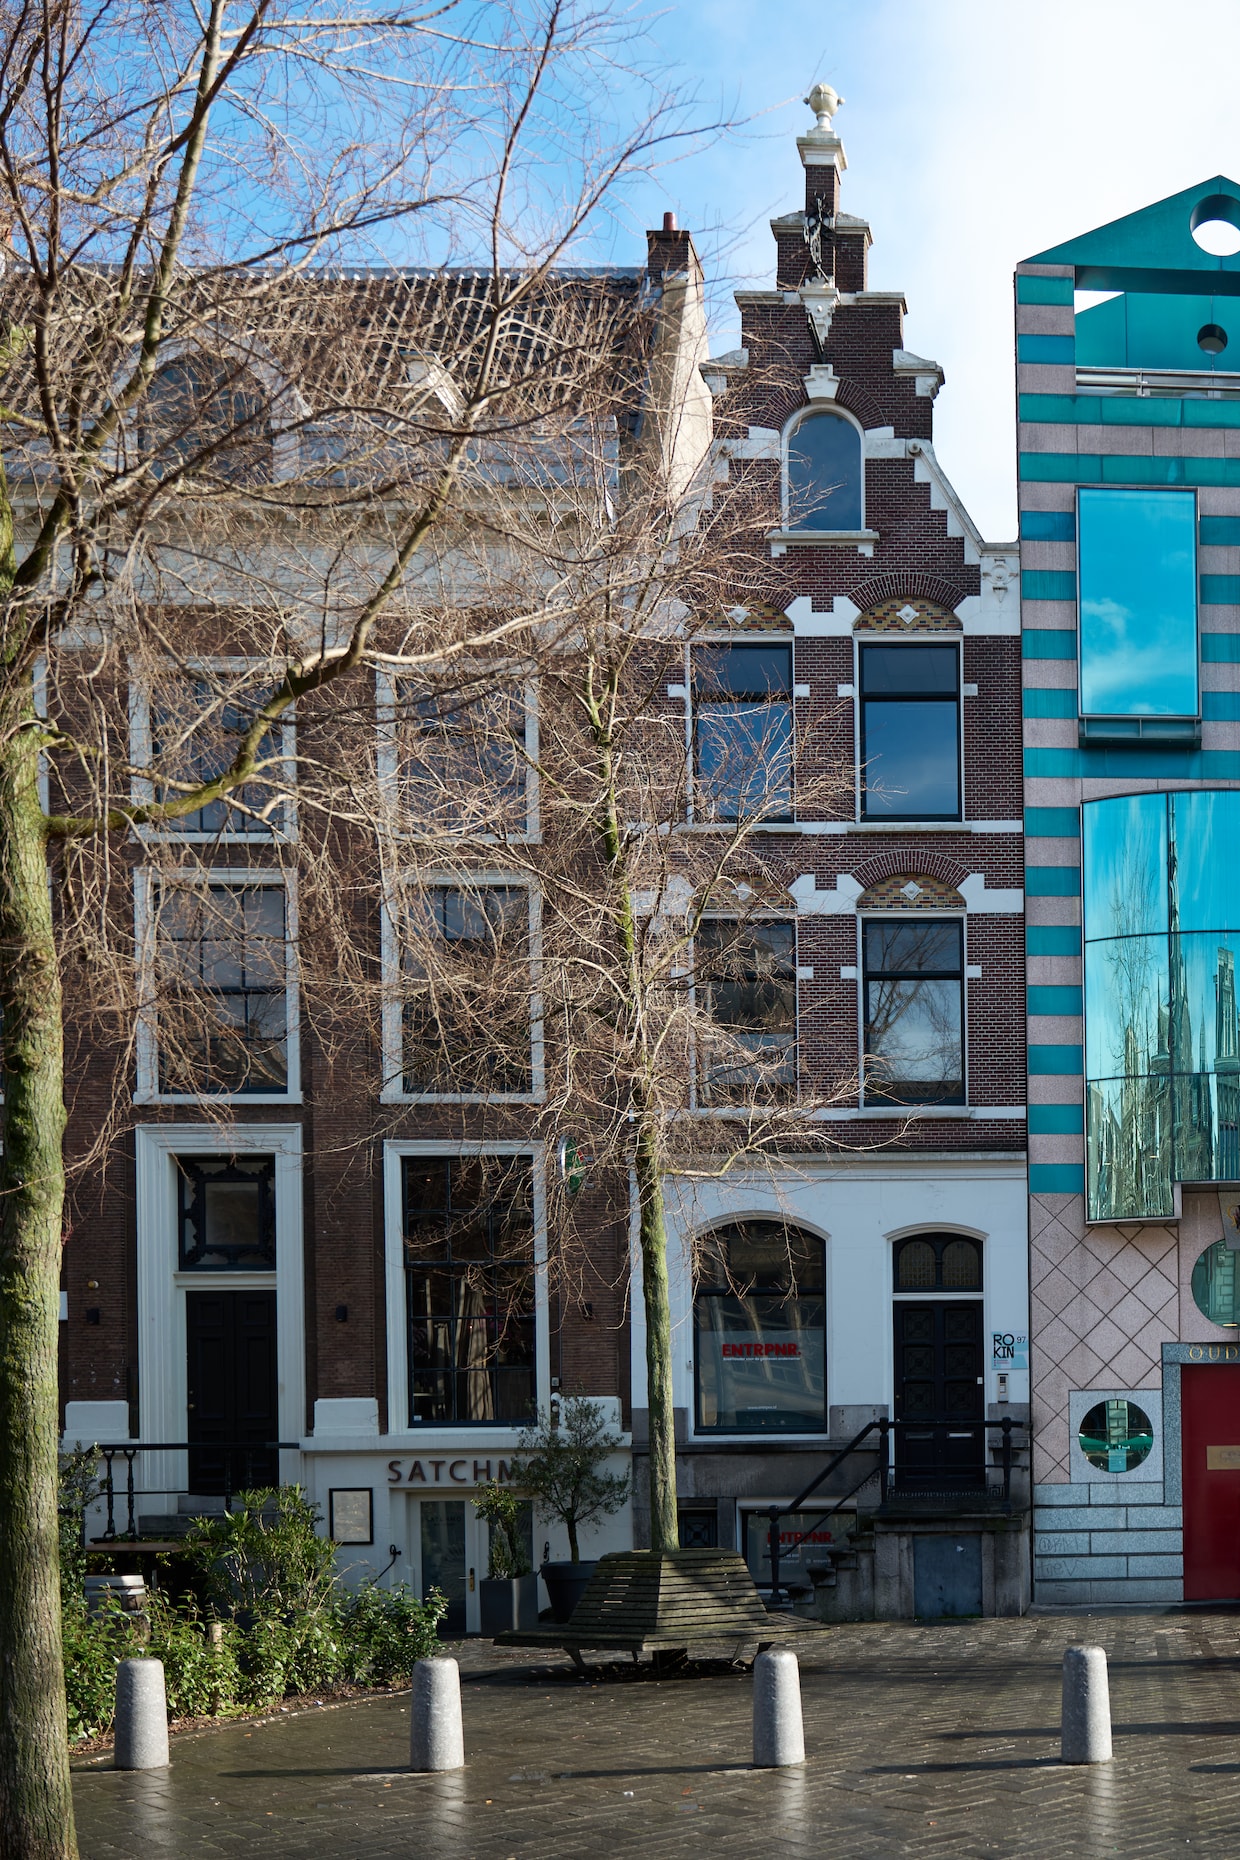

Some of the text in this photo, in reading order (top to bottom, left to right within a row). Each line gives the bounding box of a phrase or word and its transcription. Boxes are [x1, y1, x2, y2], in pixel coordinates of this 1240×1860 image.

[993, 1333, 1015, 1346] RO
[1016, 1336, 1027, 1344] 97
[722, 1343, 802, 1357] ENTRPNR.
[993, 1346, 1015, 1359] KIN
